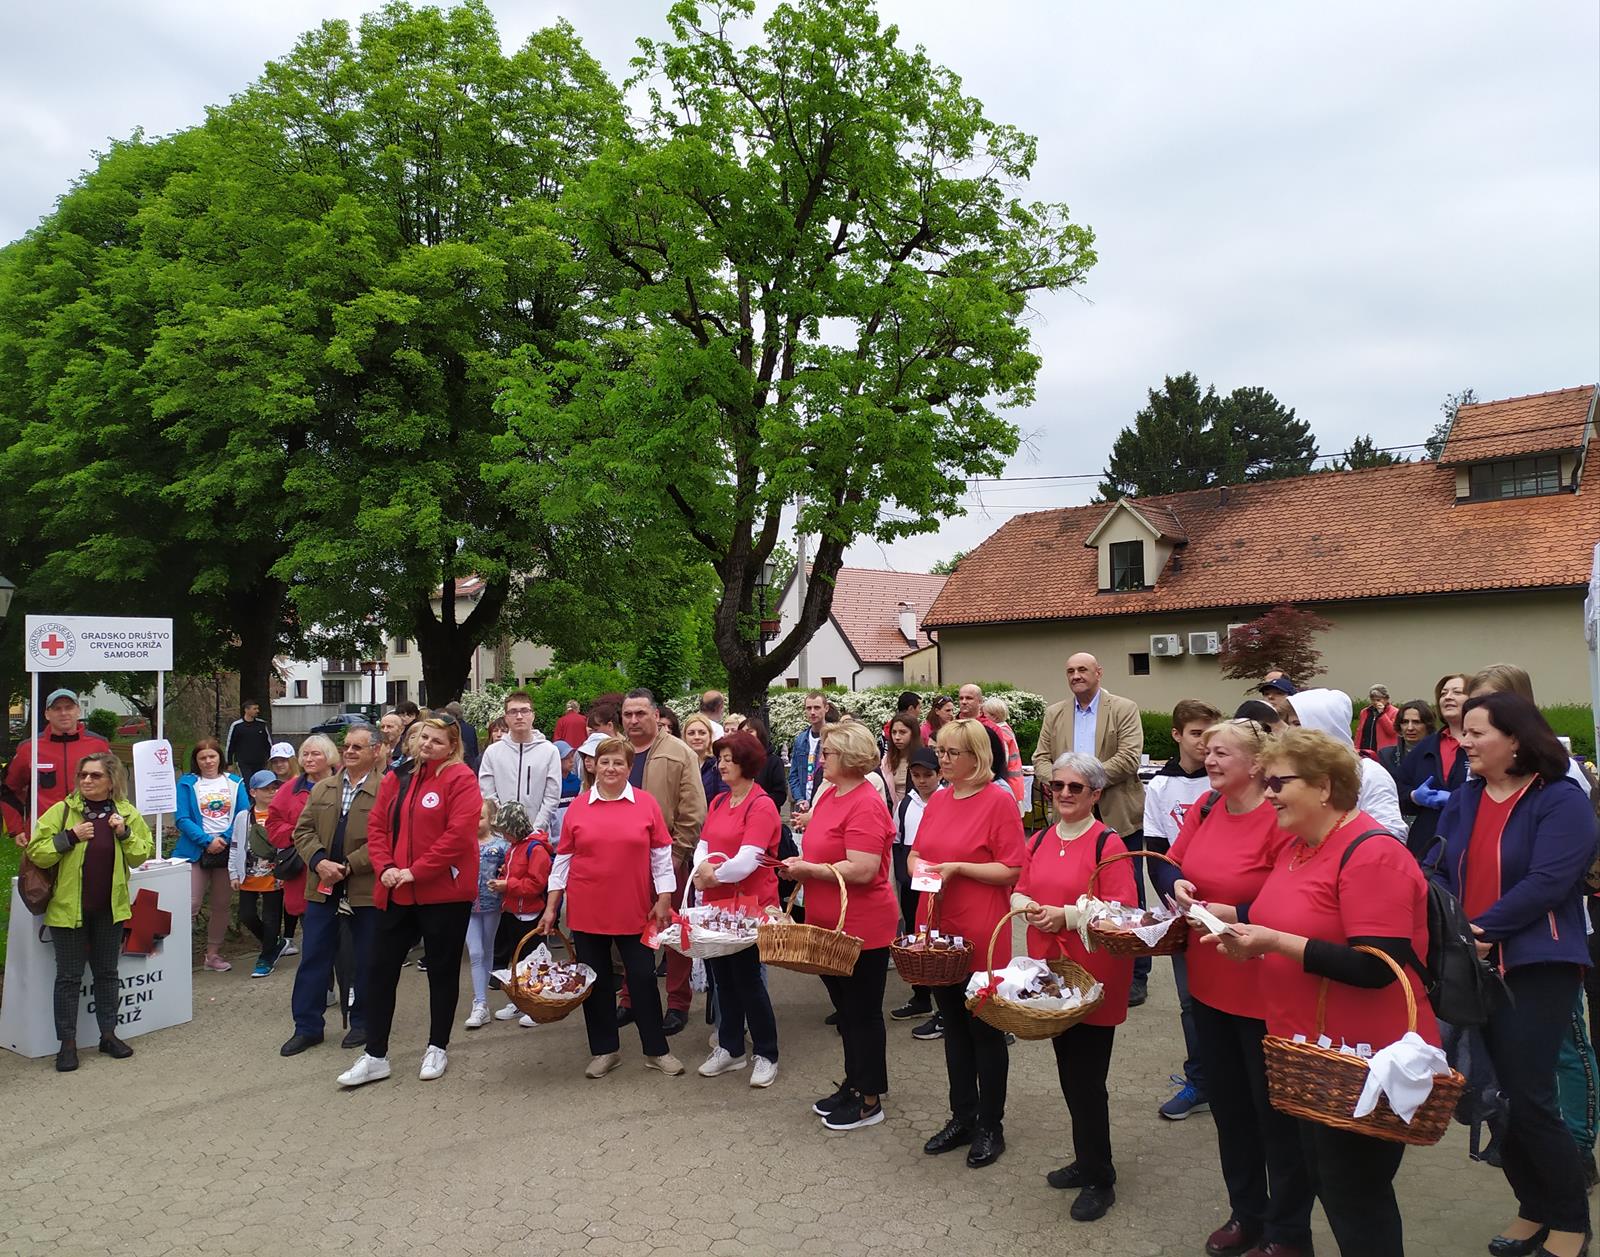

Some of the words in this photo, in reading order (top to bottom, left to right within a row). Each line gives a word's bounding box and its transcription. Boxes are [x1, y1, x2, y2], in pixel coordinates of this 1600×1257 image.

[81, 632, 126, 640] GRADSKO
[128, 631, 170, 640] DRUŠTVO
[90, 641, 135, 649] CRVENOG
[136, 640, 162, 649] KRIŽA
[116, 1006, 142, 1025] RIŽ
